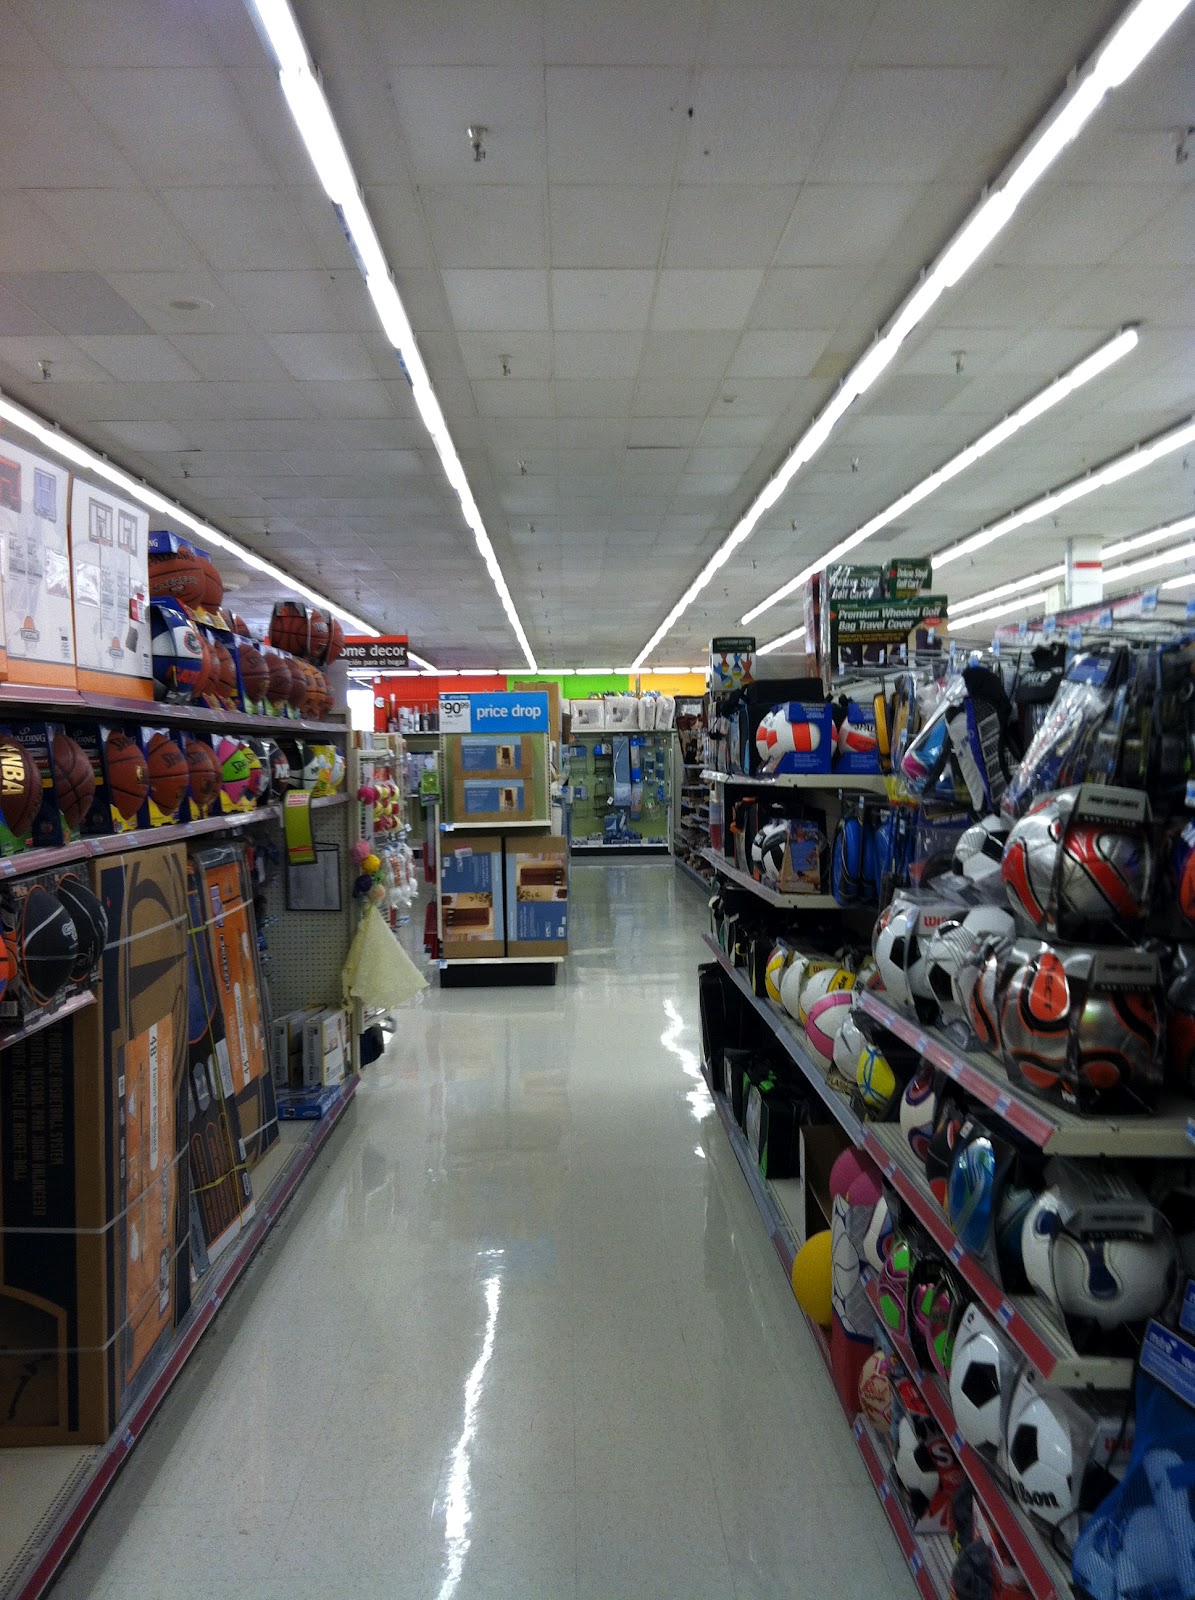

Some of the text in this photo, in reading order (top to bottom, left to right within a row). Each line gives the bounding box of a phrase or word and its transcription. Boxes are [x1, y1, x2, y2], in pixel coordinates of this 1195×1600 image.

[860, 576, 881, 587] Steel
[897, 579, 908, 588] Golf
[831, 589, 849, 600] Golf
[838, 606, 941, 620] Premium Wheeled Golf
[838, 620, 857, 632] Bag
[859, 620, 887, 631] Travel
[887, 619, 914, 631] Cover
[340, 644, 406, 657] ome decor
[364, 660, 379, 668] para
[379, 659, 387, 667] el
[387, 659, 406, 667] hogar
[476, 703, 542, 721] price drop
